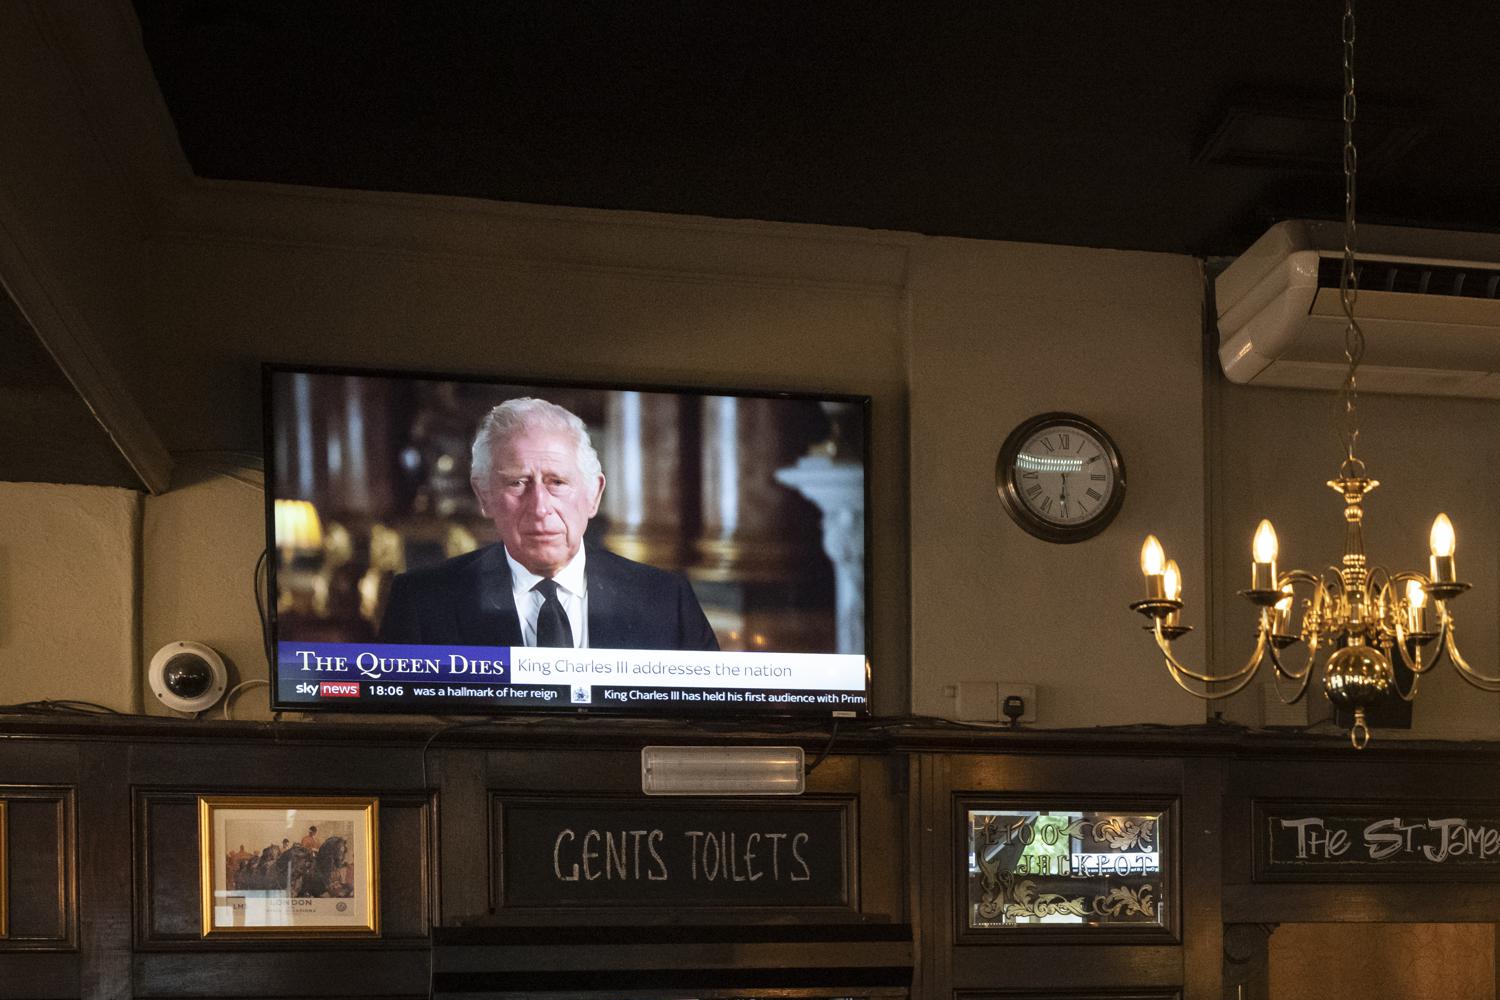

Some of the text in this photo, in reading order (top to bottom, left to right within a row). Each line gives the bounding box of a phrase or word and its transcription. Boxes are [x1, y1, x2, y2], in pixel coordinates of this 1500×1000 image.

[295, 650, 504, 679] THE QUEEN DIES
[517, 658, 792, 678] King Charles III addresses the nation
[296, 681, 319, 698] sky
[322, 684, 358, 696] news
[368, 685, 404, 697] 18:06
[413, 686, 557, 701] was a hallmark of her reign
[604, 689, 627, 702] King
[628, 689, 669, 701] Charles
[670, 690, 680, 701] III
[681, 690, 701, 702] has
[702, 690, 724, 702] held
[727, 691, 743, 702] his
[745, 691, 767, 703] first
[768, 692, 815, 704] audience
[816, 692, 839, 704] with
[553, 828, 811, 882] GENTS TOILETS
[1015, 854, 1154, 878] JACKPOT
